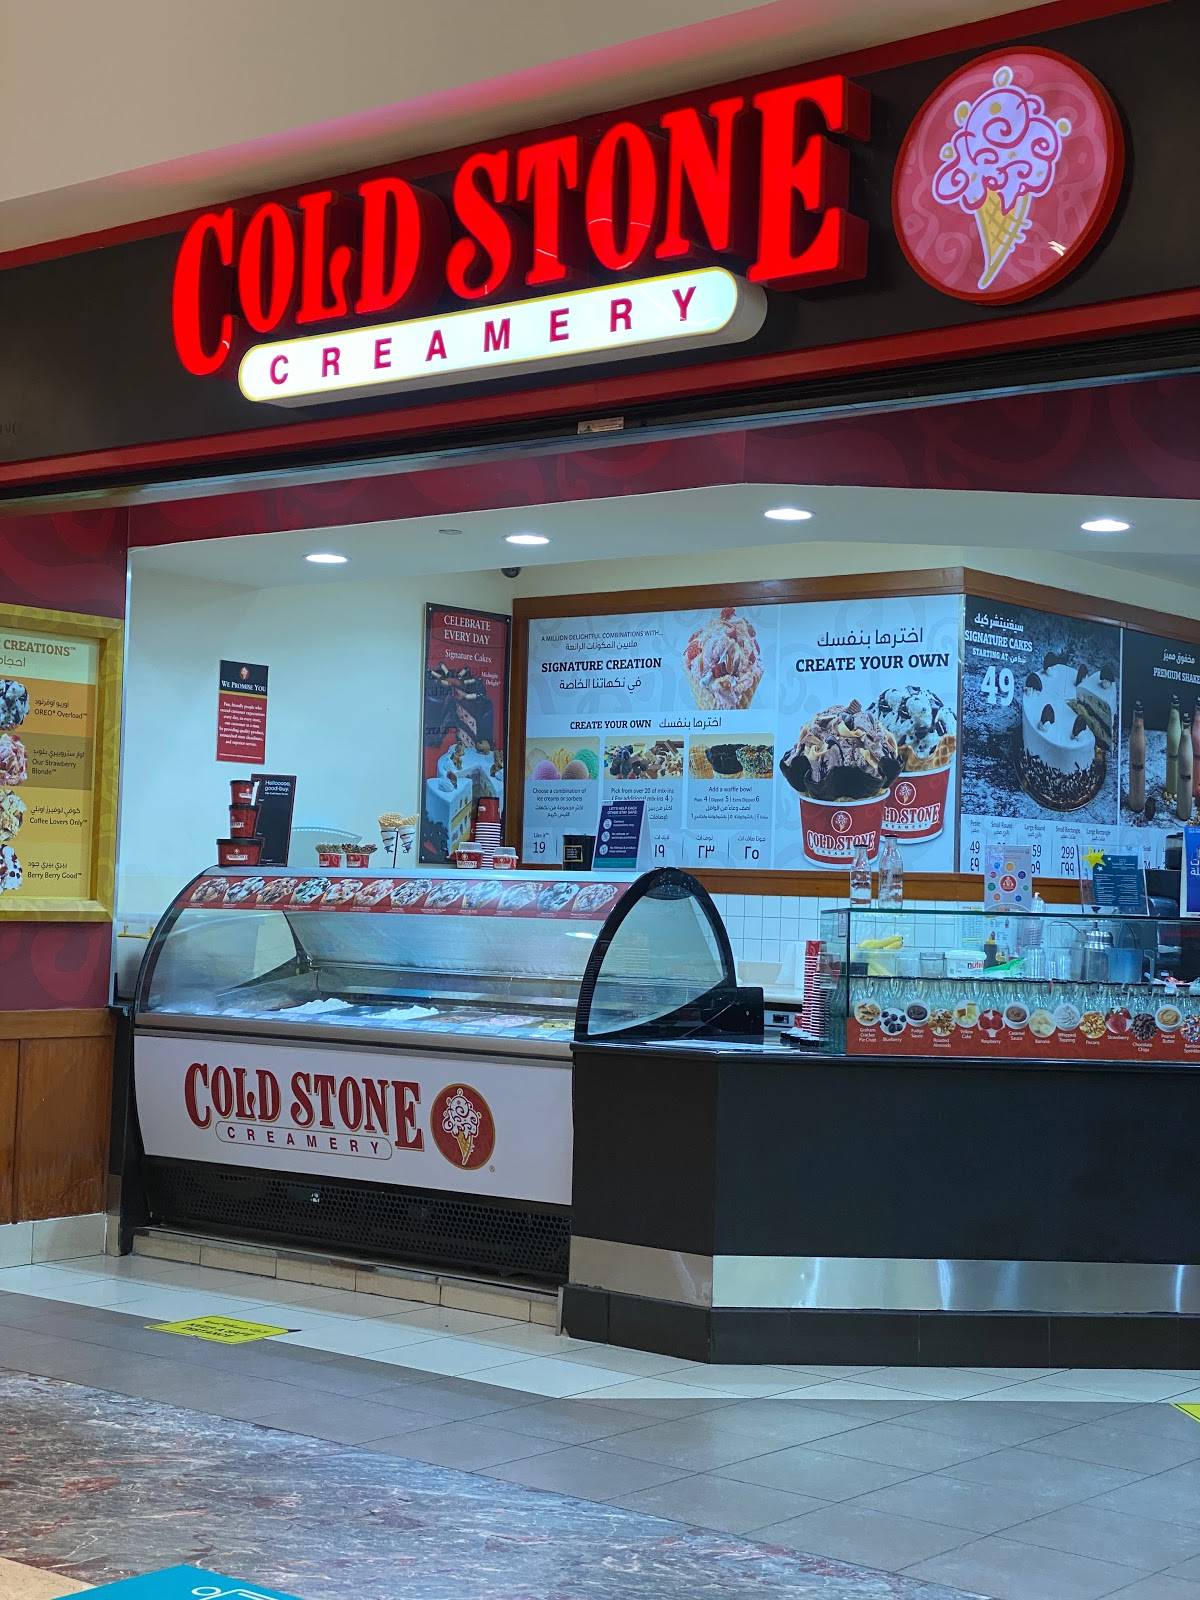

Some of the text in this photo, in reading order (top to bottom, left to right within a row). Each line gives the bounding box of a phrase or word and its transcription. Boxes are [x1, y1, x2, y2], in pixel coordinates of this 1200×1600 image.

[172, 76, 848, 377] COLD STONE
[270, 285, 697, 385] CREAMERY
[444, 615, 491, 631] CELEBRATE
[444, 629, 490, 645] EVERY DAY
[602, 631, 644, 639] COMBINATIONS
[817, 627, 923, 649] اخترها بنفسك
[964, 630, 1032, 652] SIGNATURE CAKES
[445, 649, 492, 663] Signature Cakes
[972, 648, 1008, 660] STARTING AT
[542, 658, 662, 673] SIGNATURE CREATION
[796, 653, 950, 672] CREATE YOUR OWN
[1153, 667, 1181, 680] PREMIUM
[232, 681, 253, 690] PROMISE
[560, 676, 642, 694] في نكهاتنا الخاصة
[981, 666, 1014, 706] 49
[570, 720, 652, 730] CREATE YOUR OWN
[658, 716, 722, 730] اخترها بنفسك
[45, 760, 76, 768] Strawberry
[883, 803, 940, 824] LD STONE
[533, 841, 546, 854] 19
[807, 830, 876, 851] COLD STONE
[654, 844, 759, 859] ١٩ ٢٣ ٢٥
[970, 841, 1074, 859] 49 59 299
[45, 872, 60, 880] Berry
[184, 1063, 425, 1152] COLD STONE
[227, 1126, 380, 1155] CREAMERY
